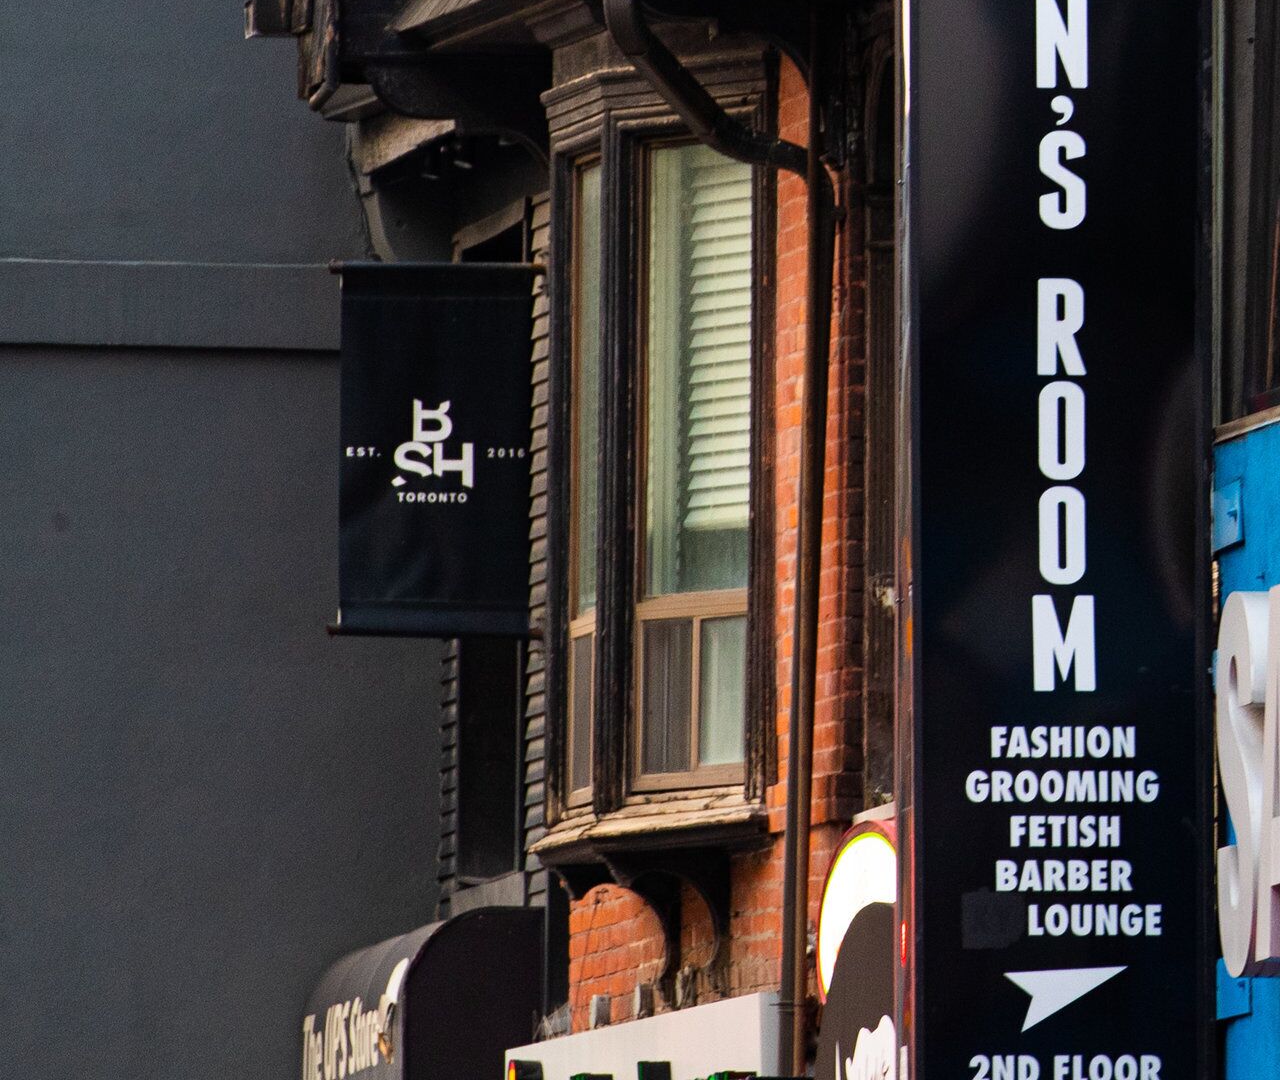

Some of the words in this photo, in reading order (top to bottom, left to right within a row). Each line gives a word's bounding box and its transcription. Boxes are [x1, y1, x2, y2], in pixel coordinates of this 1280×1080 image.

[345, 446, 382, 458] EST.
[486, 447, 526, 459] 2016
[396, 491, 468, 504] TORONTO
[1032, 277, 1097, 692] ROOM
[990, 726, 1137, 758] FASHION
[965, 770, 1160, 803] GROOMING
[1010, 816, 1121, 848] FETISH
[995, 860, 1133, 892] BARBER
[1027, 904, 1162, 937] LOUNGE
[302, 1013, 323, 1080] The
[323, 1000, 351, 1080] UPS
[348, 995, 380, 1076] Store
[968, 1054, 1040, 1080] 2ND
[1053, 1054, 1162, 1080] FLOOR
